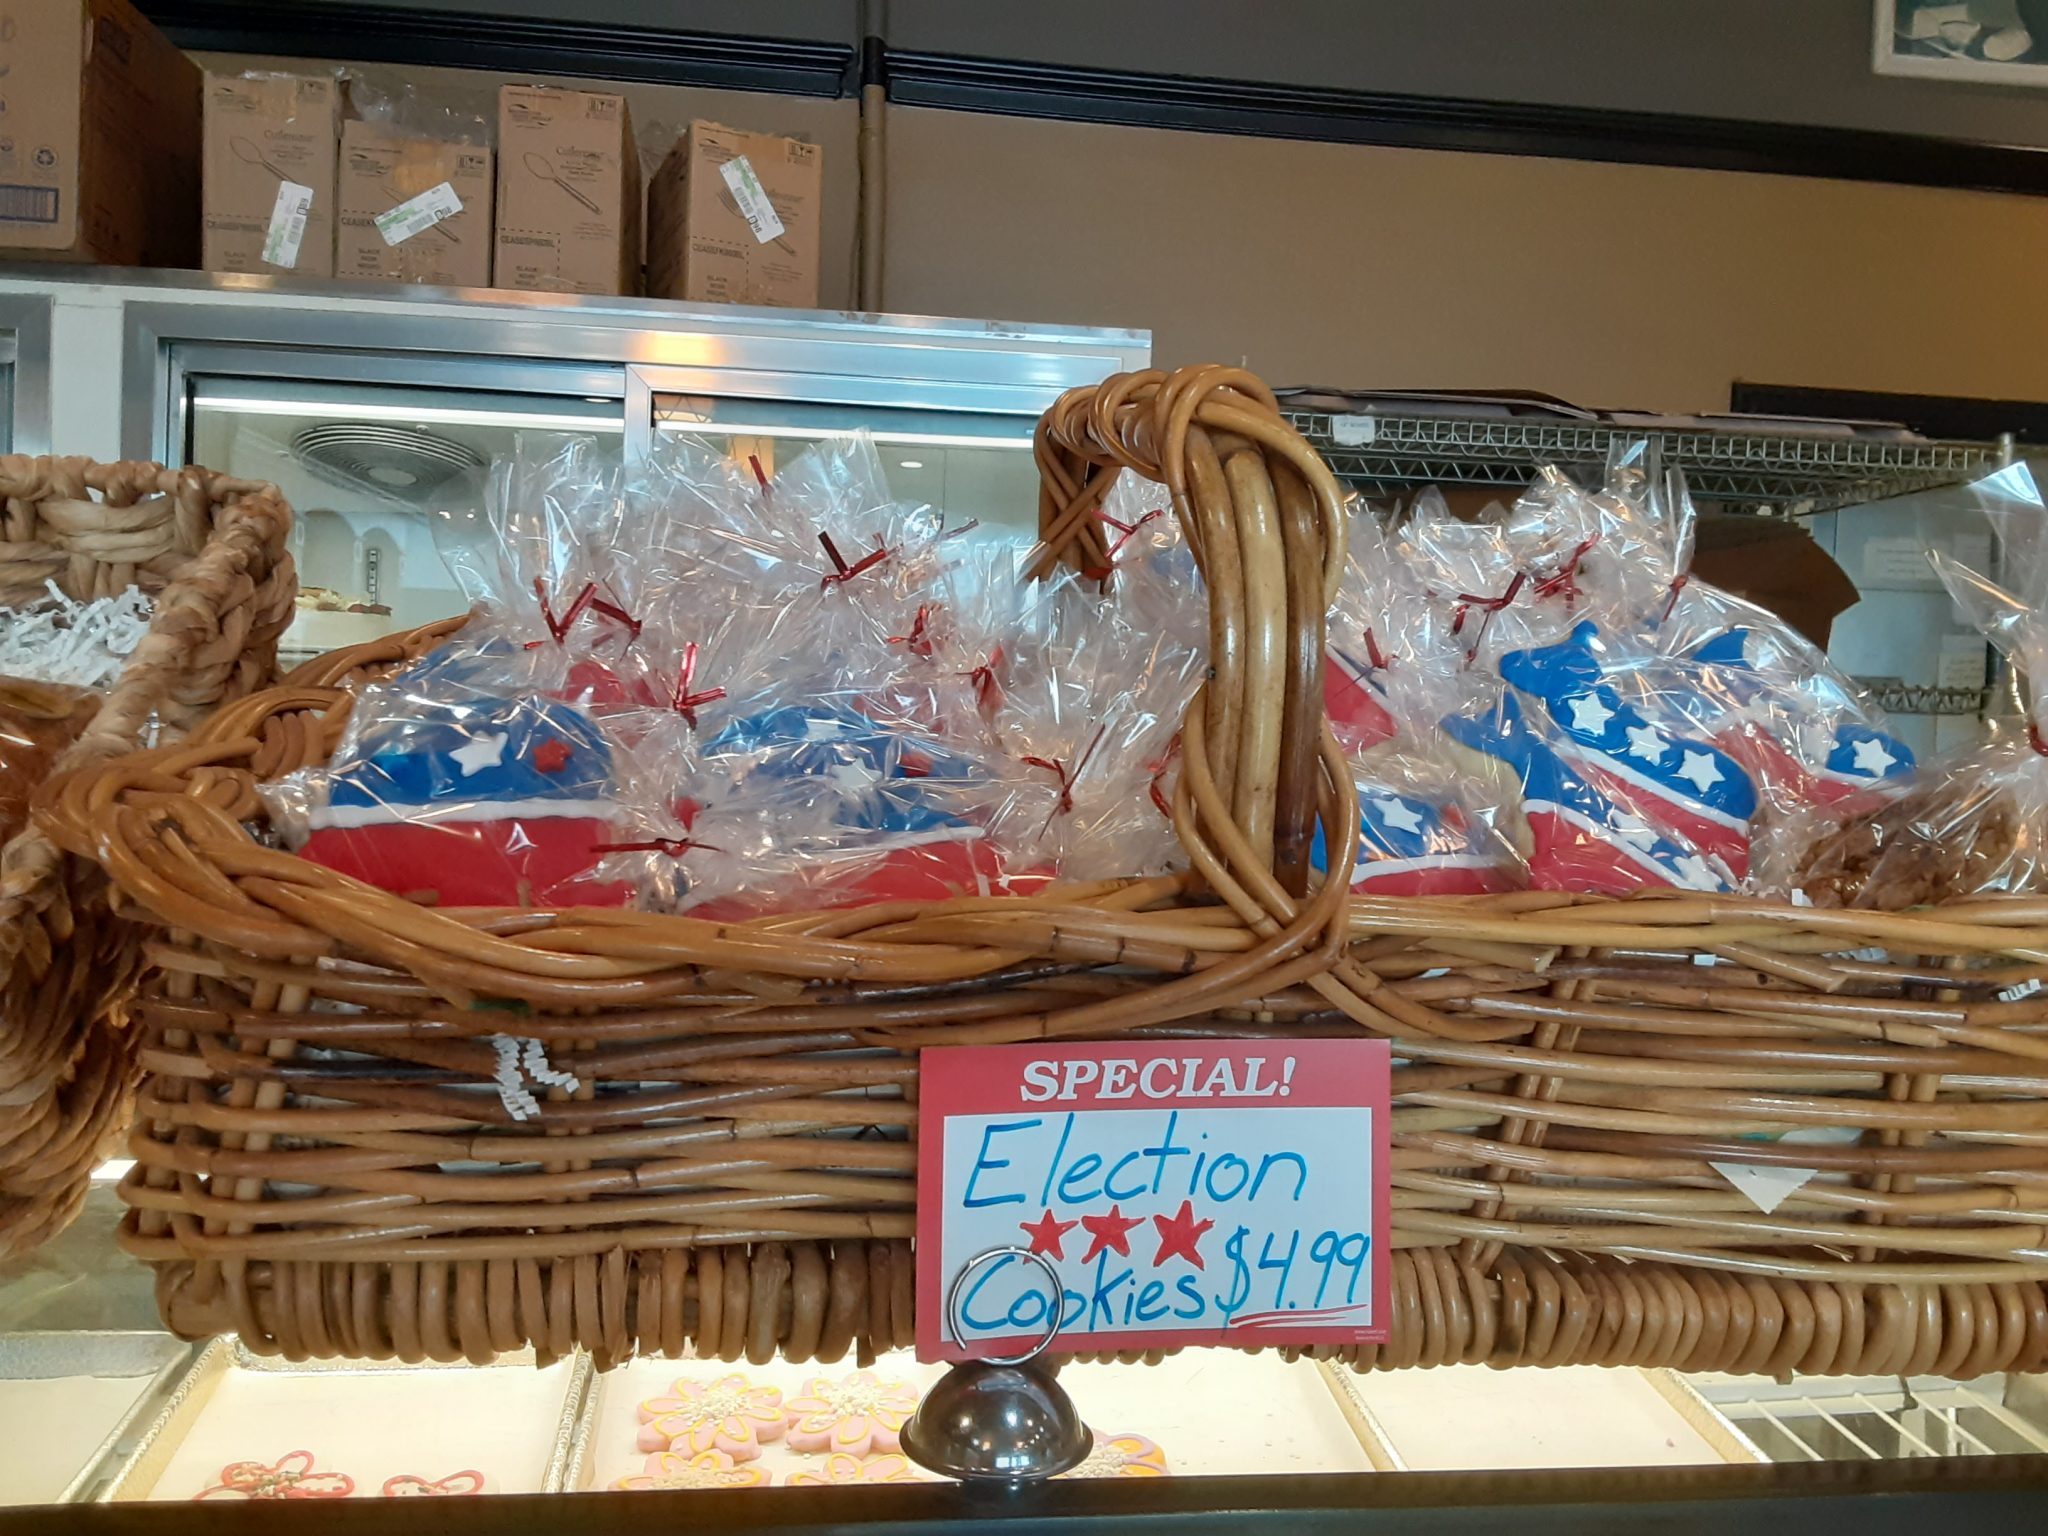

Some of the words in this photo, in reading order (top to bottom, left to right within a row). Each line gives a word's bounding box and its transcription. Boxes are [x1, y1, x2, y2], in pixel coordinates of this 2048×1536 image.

[1020, 1057, 1296, 1101] SPECIAL!
[963, 1111, 1308, 1208] Election
[960, 1249, 1207, 1332] Cookies
[1215, 1225, 1371, 1339] $4.99
